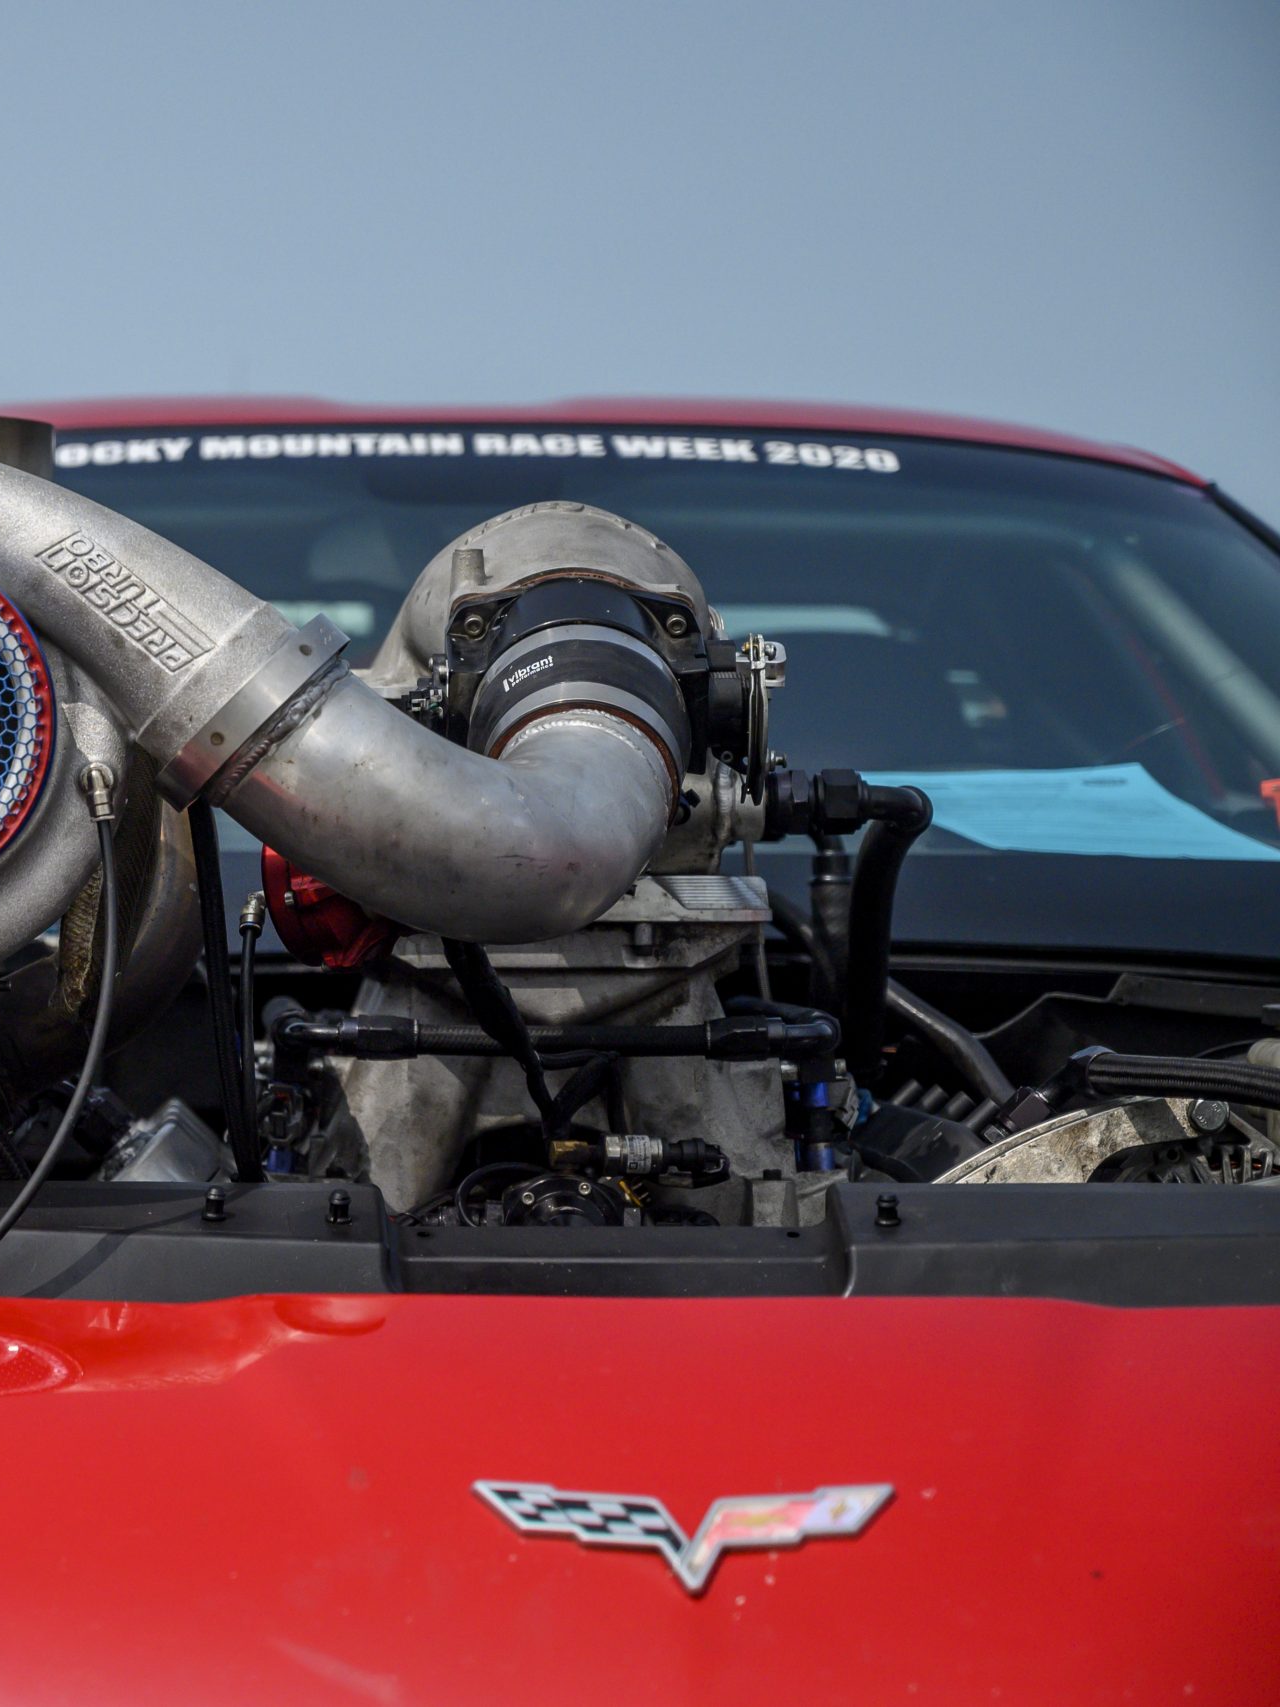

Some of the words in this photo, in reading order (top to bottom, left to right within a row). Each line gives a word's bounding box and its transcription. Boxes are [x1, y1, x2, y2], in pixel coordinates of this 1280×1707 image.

[54, 436, 192, 468] OCKY
[199, 433, 465, 460] MOUNTAIN
[473, 433, 607, 458] RACE
[611, 435, 758, 463] WEEK
[763, 440, 900, 474] 2020
[67, 532, 162, 616] TURBO
[38, 545, 195, 672] PRECISION
[508, 655, 554, 684] vibrant
